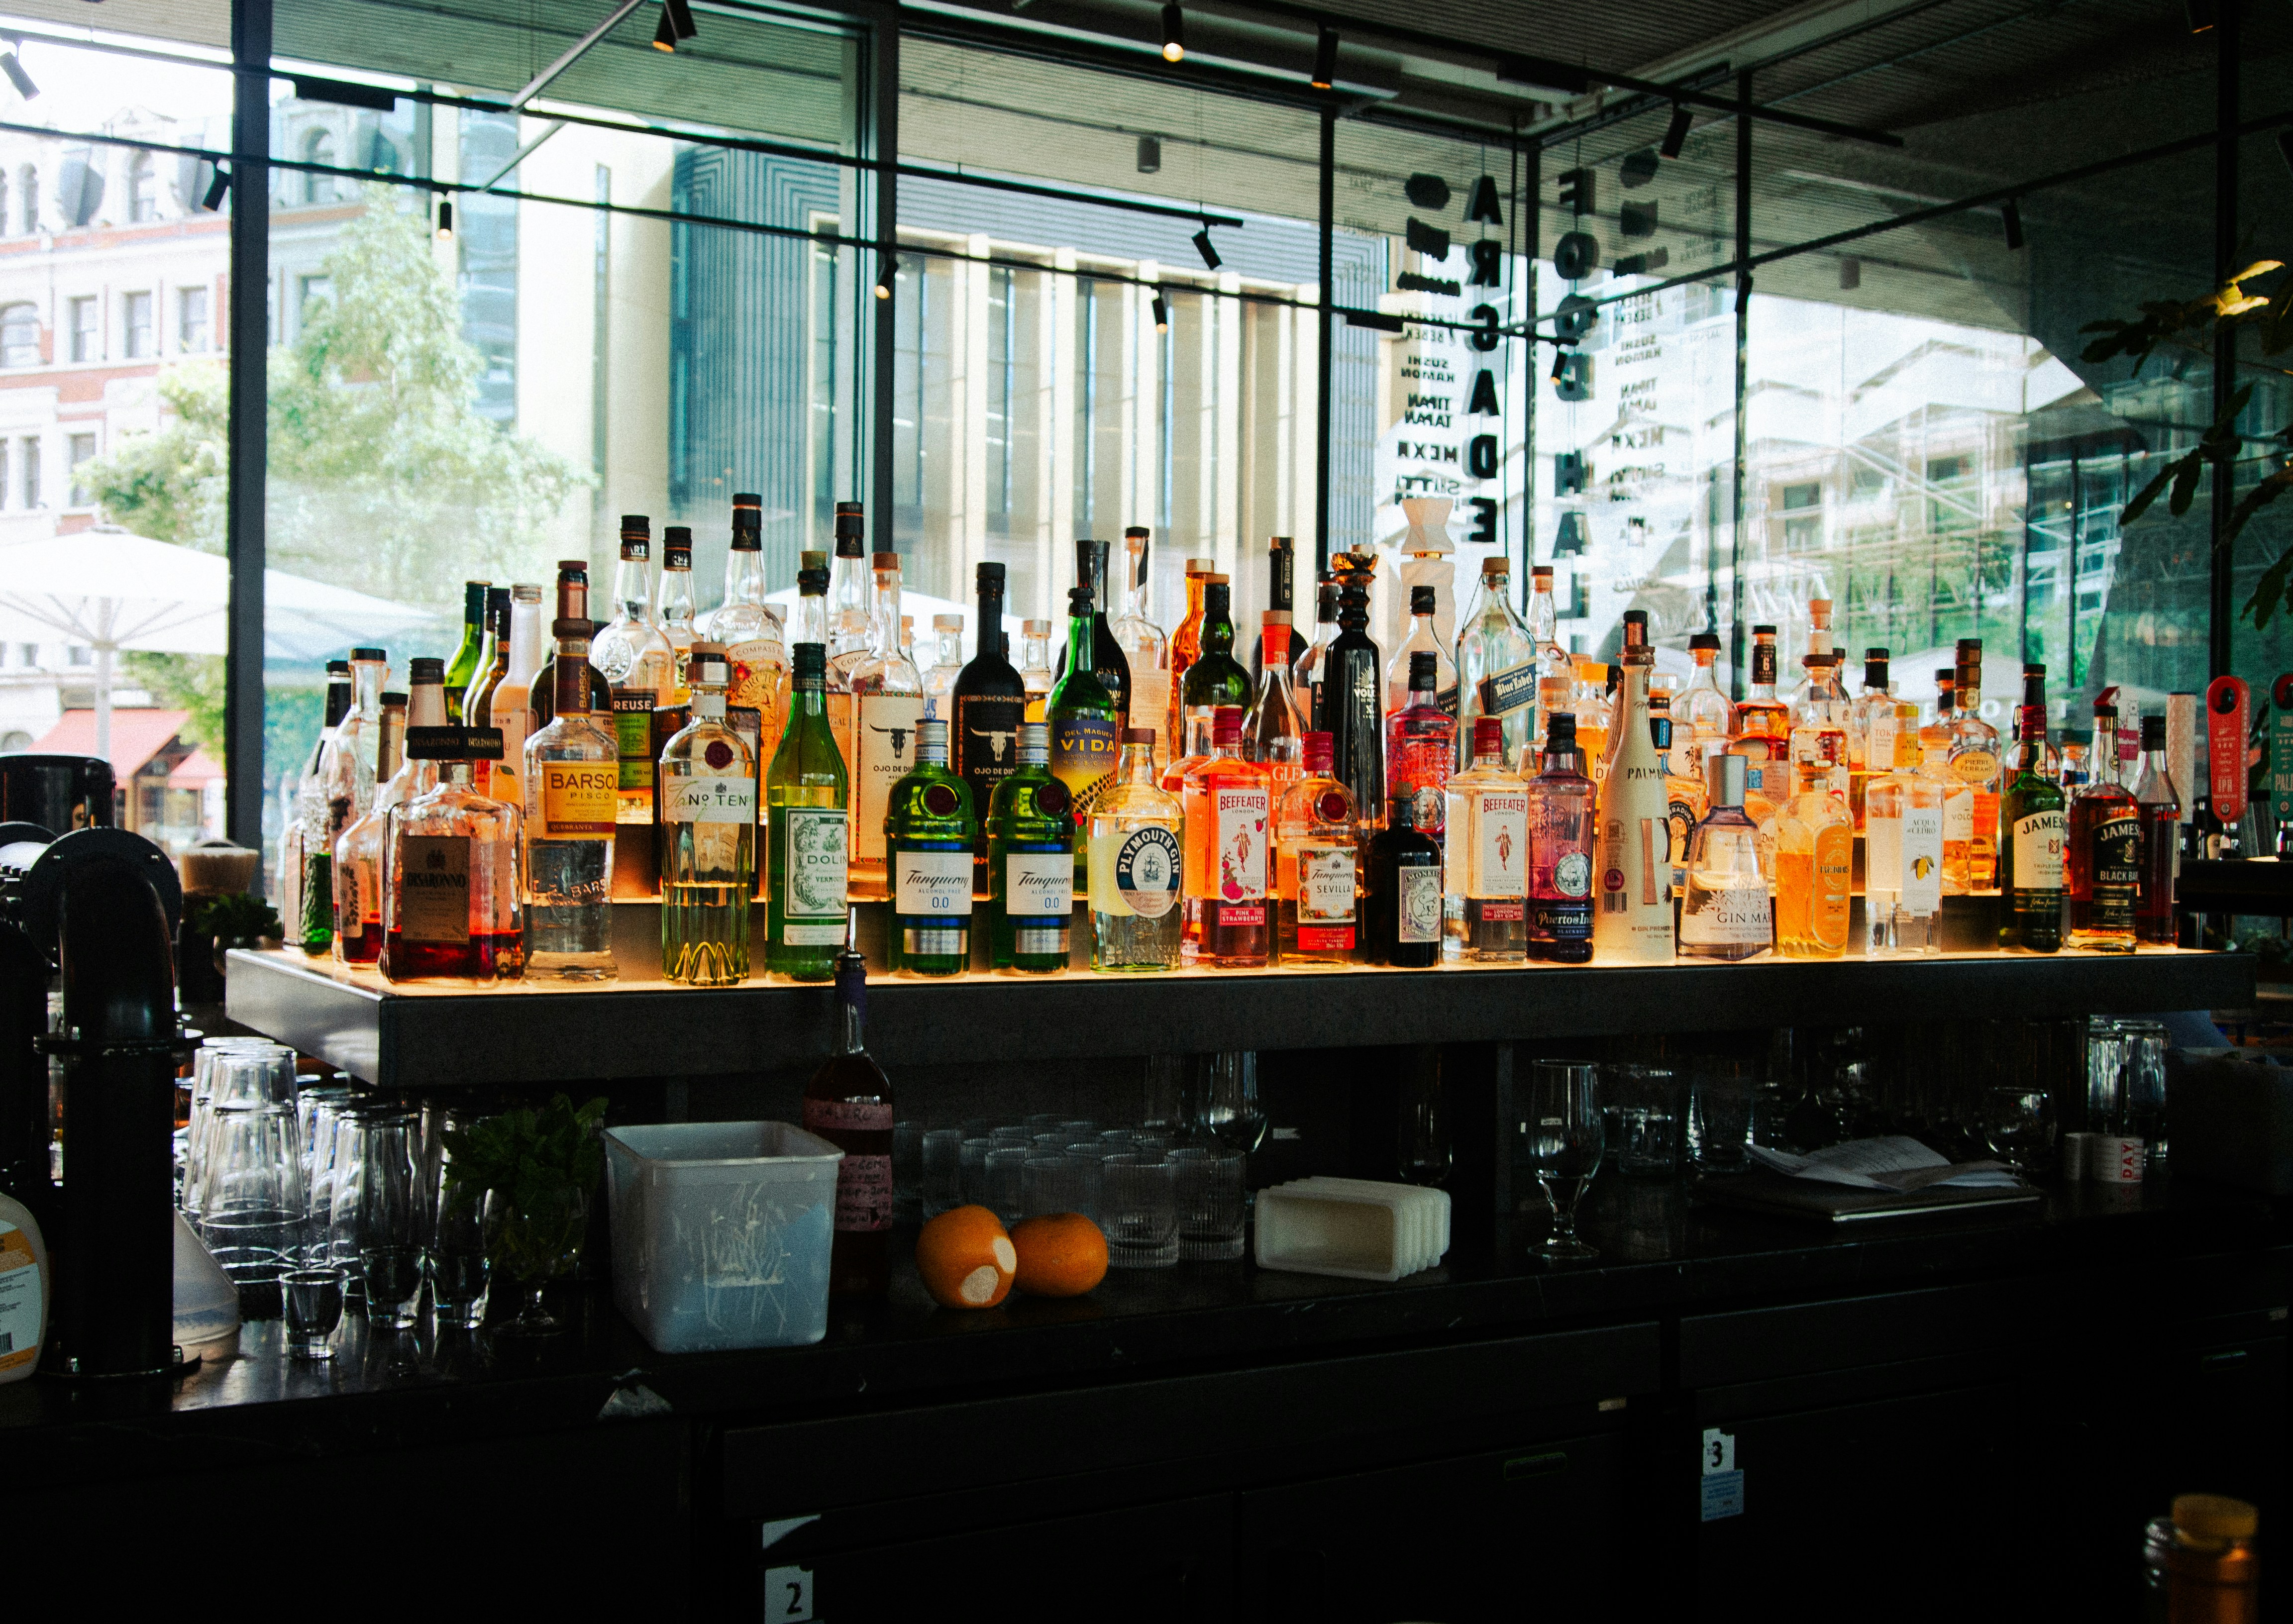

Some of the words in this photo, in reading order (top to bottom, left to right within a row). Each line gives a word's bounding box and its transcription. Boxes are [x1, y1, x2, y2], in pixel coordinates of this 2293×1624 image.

[736, 645, 777, 657] COMPASS
[1763, 657, 1770, 671] 6
[579, 665, 588, 709] BARSOL
[1060, 738, 1115, 753] VIDA
[551, 773, 618, 790] BARSOL
[715, 795, 747, 807] TEN
[1220, 796, 1266, 812] BEEFEATER
[1483, 798, 1526, 813] BEEFEATER
[1119, 829, 1173, 874] PLYMOUTH
[1170, 848, 1180, 874] GIN
[407, 872, 466, 888] DISARONNO
[906, 869, 969, 889] Tanqueray
[2100, 870, 2127, 881] BLACK
[1317, 885, 1351, 894] SEVILLA
[932, 897, 949, 909] 0.0
[1044, 897, 1059, 909] 0.0
[1538, 911, 1573, 926] Puerto
[1717, 912, 1746, 923] GIN
[2122, 1143, 2133, 1179] DAY
[1712, 1440, 1723, 1468] 3
[786, 1581, 802, 1615] 2
